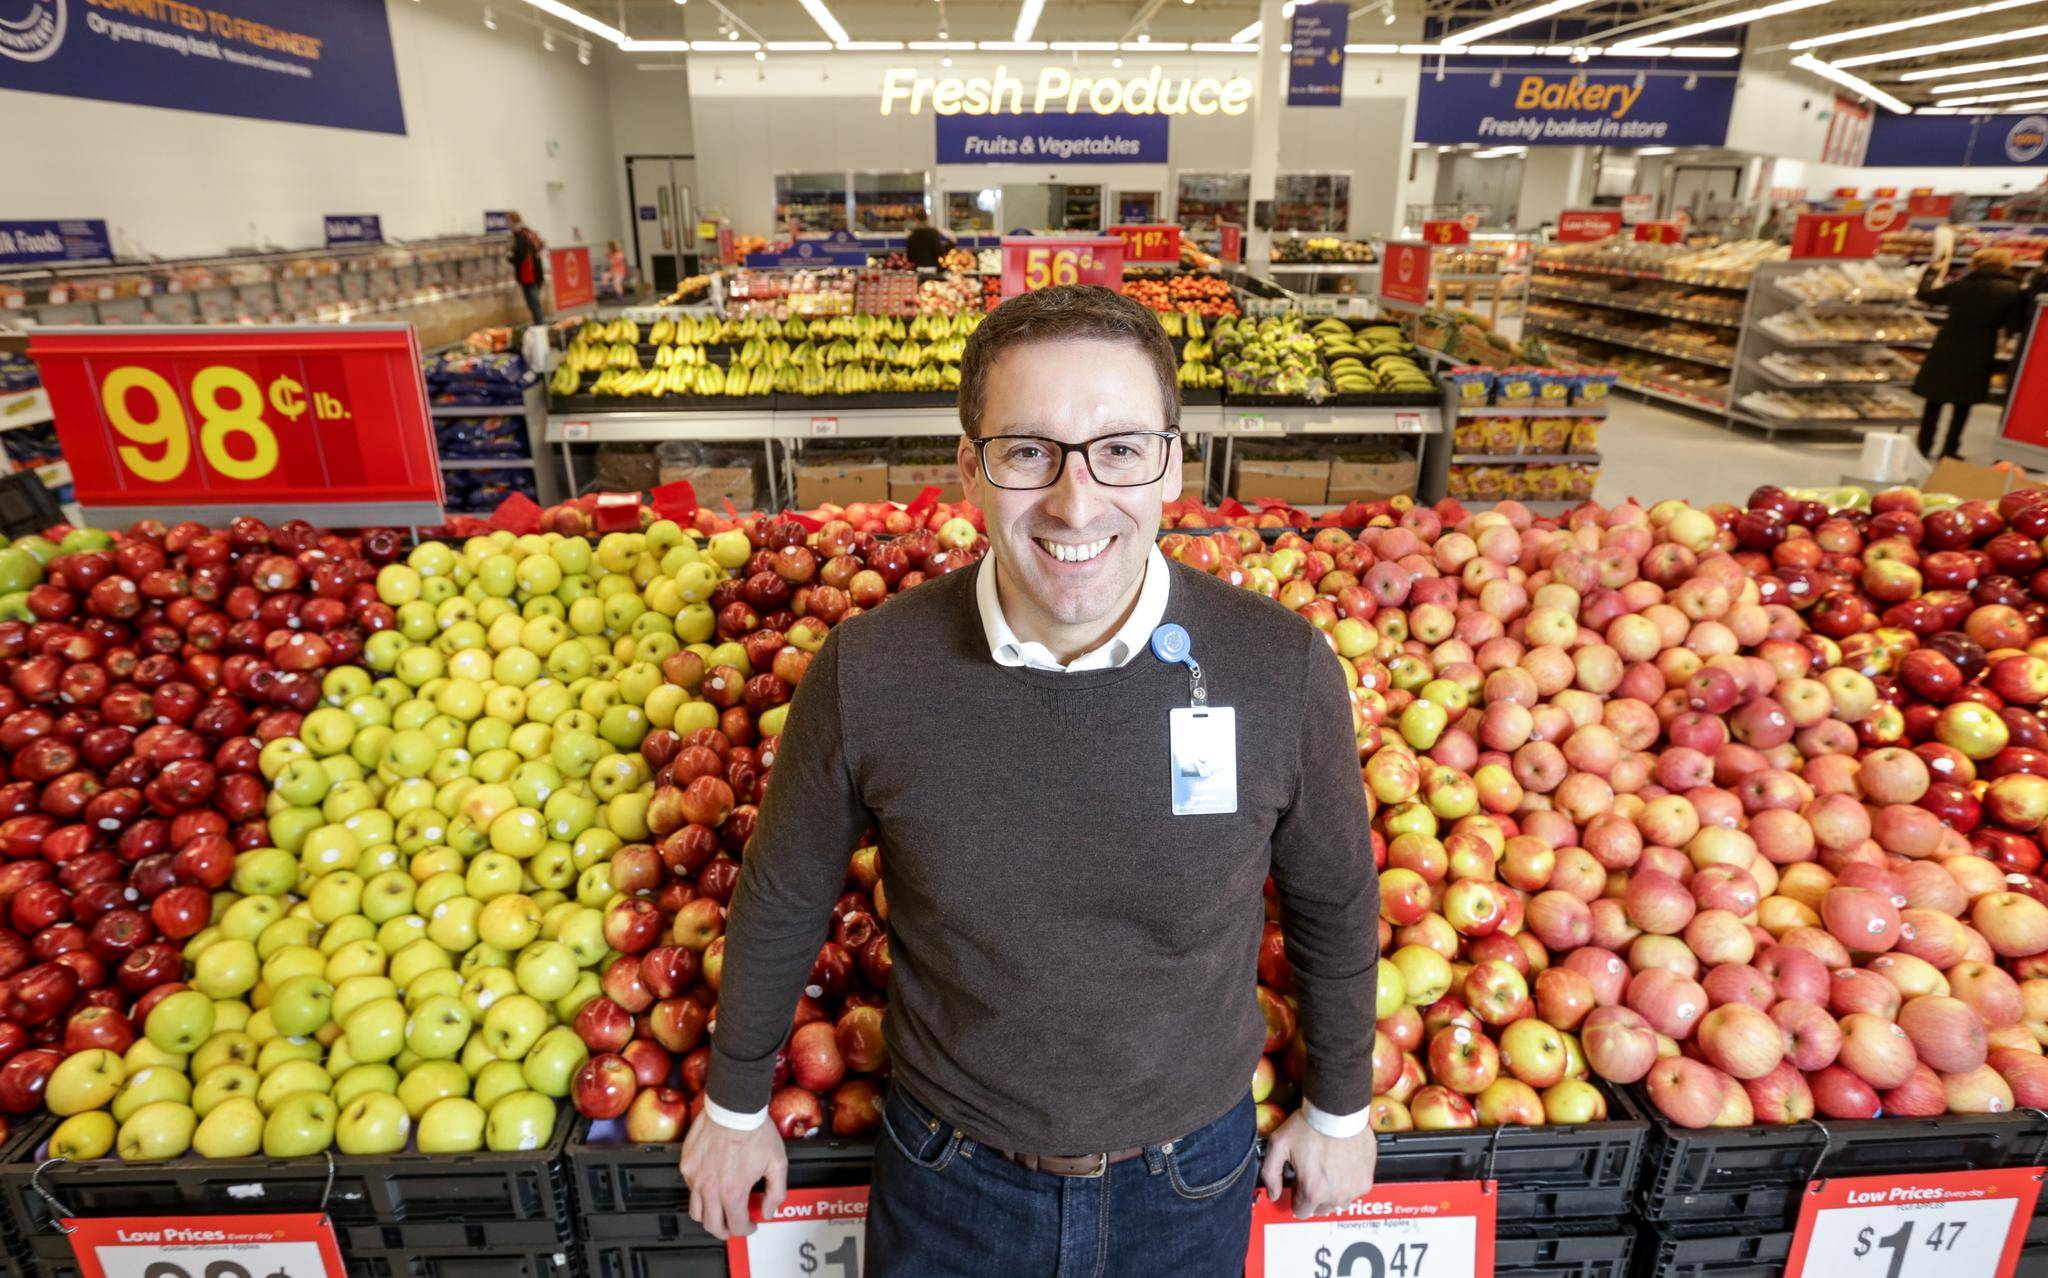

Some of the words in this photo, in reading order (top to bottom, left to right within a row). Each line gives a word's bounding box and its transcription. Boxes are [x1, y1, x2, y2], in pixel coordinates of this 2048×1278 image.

[880, 65, 1023, 116] Fresh
[1034, 65, 1253, 116] Produce
[1515, 75, 1644, 119] Bakery
[1478, 117, 1544, 141] Freshly
[1543, 117, 1602, 138] baked
[1601, 117, 1619, 138] in
[1619, 121, 1668, 138] store
[965, 135, 1018, 155] Fruits
[1019, 135, 1035, 155] &
[1038, 135, 1141, 159] Vegetables
[314, 391, 352, 420] lb.
[1847, 1190, 1887, 1204] Low
[1889, 1186, 1944, 1201] Prices
[117, 1229, 160, 1243] Low
[163, 1227, 226, 1242] Prices
[1337, 1220, 1382, 1231] Honeycrisp
[1383, 1218, 1411, 1228] Apples
